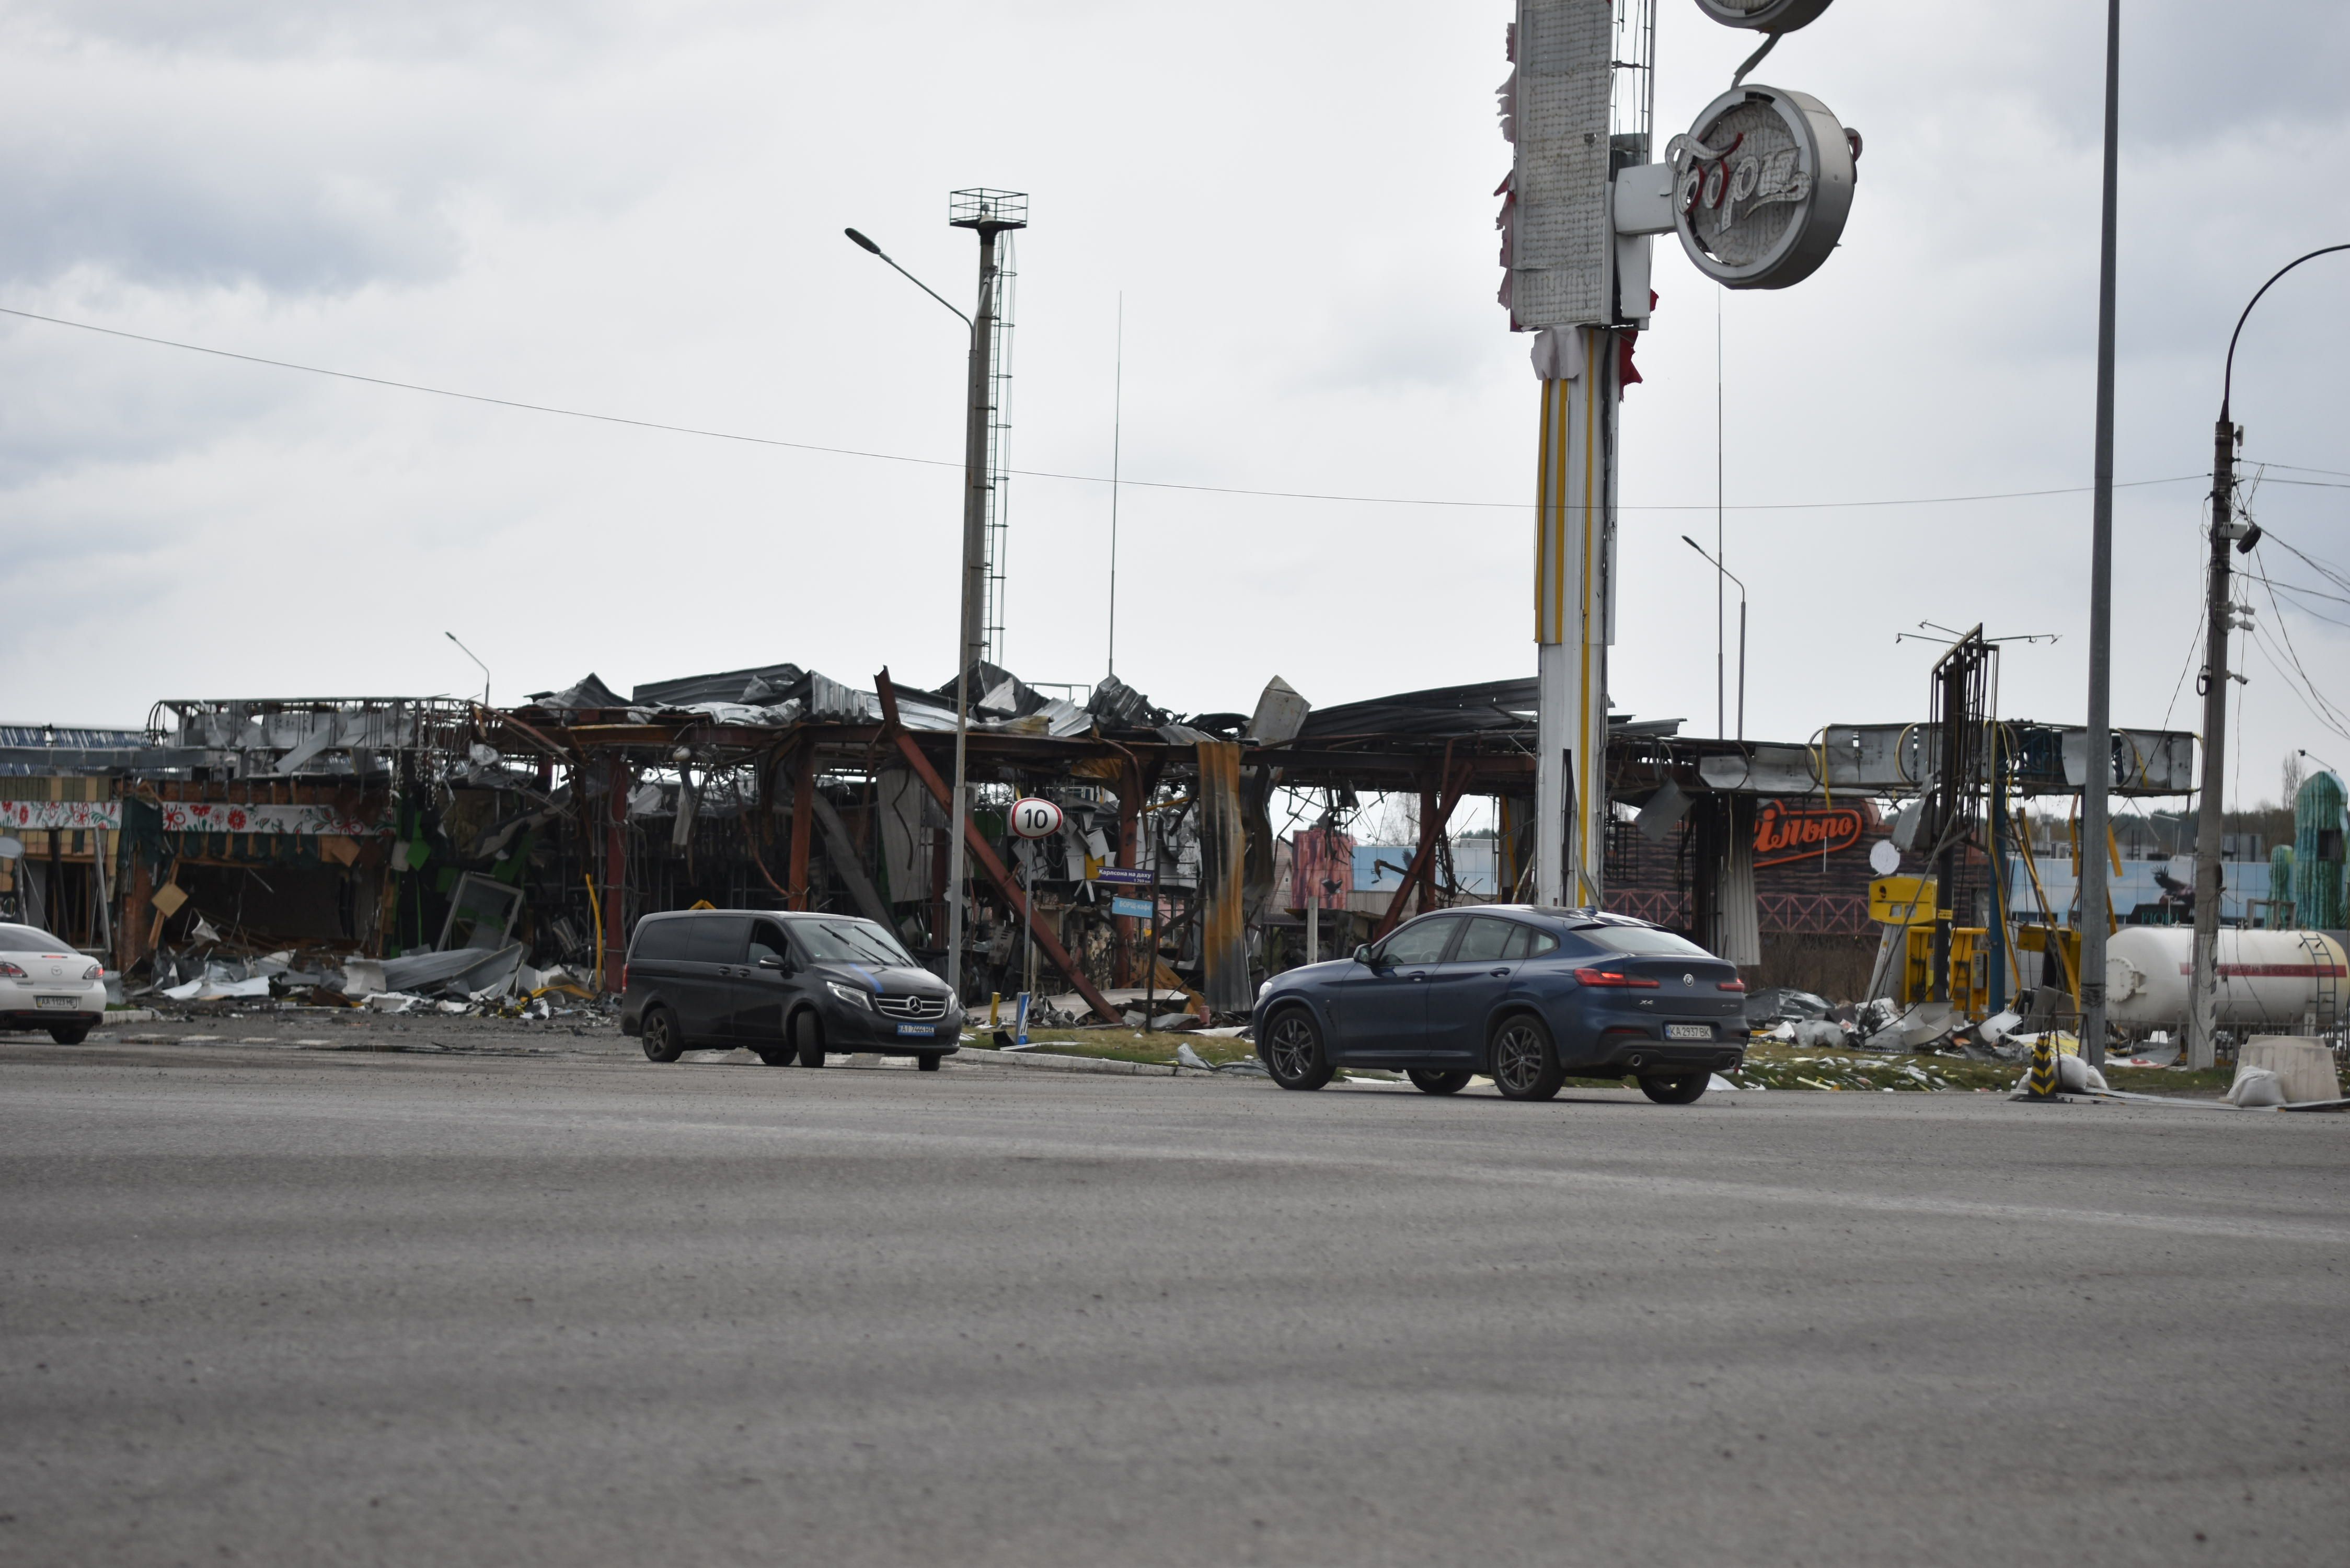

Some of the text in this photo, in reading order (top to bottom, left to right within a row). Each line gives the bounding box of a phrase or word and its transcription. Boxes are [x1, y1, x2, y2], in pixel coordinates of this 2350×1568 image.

[1024, 809, 1048, 829] 10
[1670, 1027, 1711, 1037] KA 2937 BK
